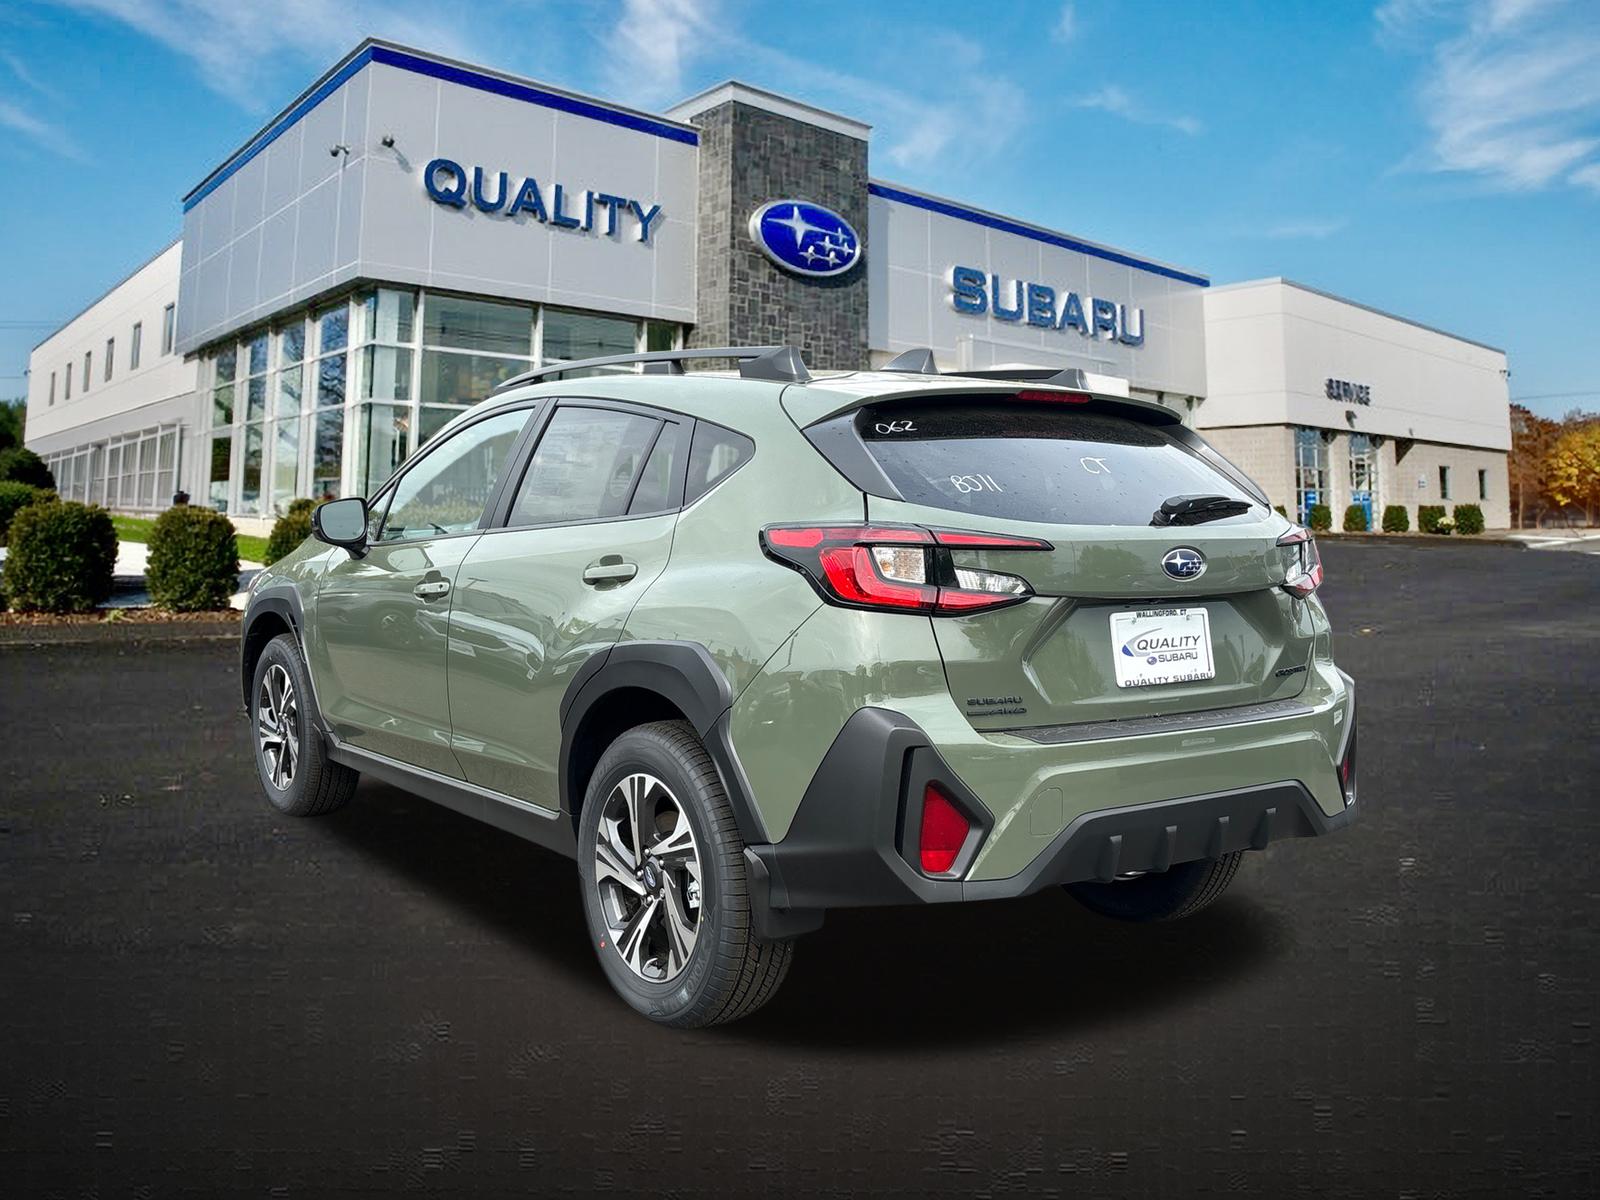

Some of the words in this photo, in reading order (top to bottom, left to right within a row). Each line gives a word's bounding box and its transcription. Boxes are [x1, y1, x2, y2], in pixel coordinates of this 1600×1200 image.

[424, 158, 661, 243] QUALITY
[951, 265, 1145, 346] SUBARU
[1137, 635, 1201, 651] QUALITY
[1158, 652, 1198, 662] SUBARU
[1125, 676, 1169, 687] QUALITY
[1173, 672, 1213, 682] SUBARU
[966, 696, 1023, 706] SUBARU
